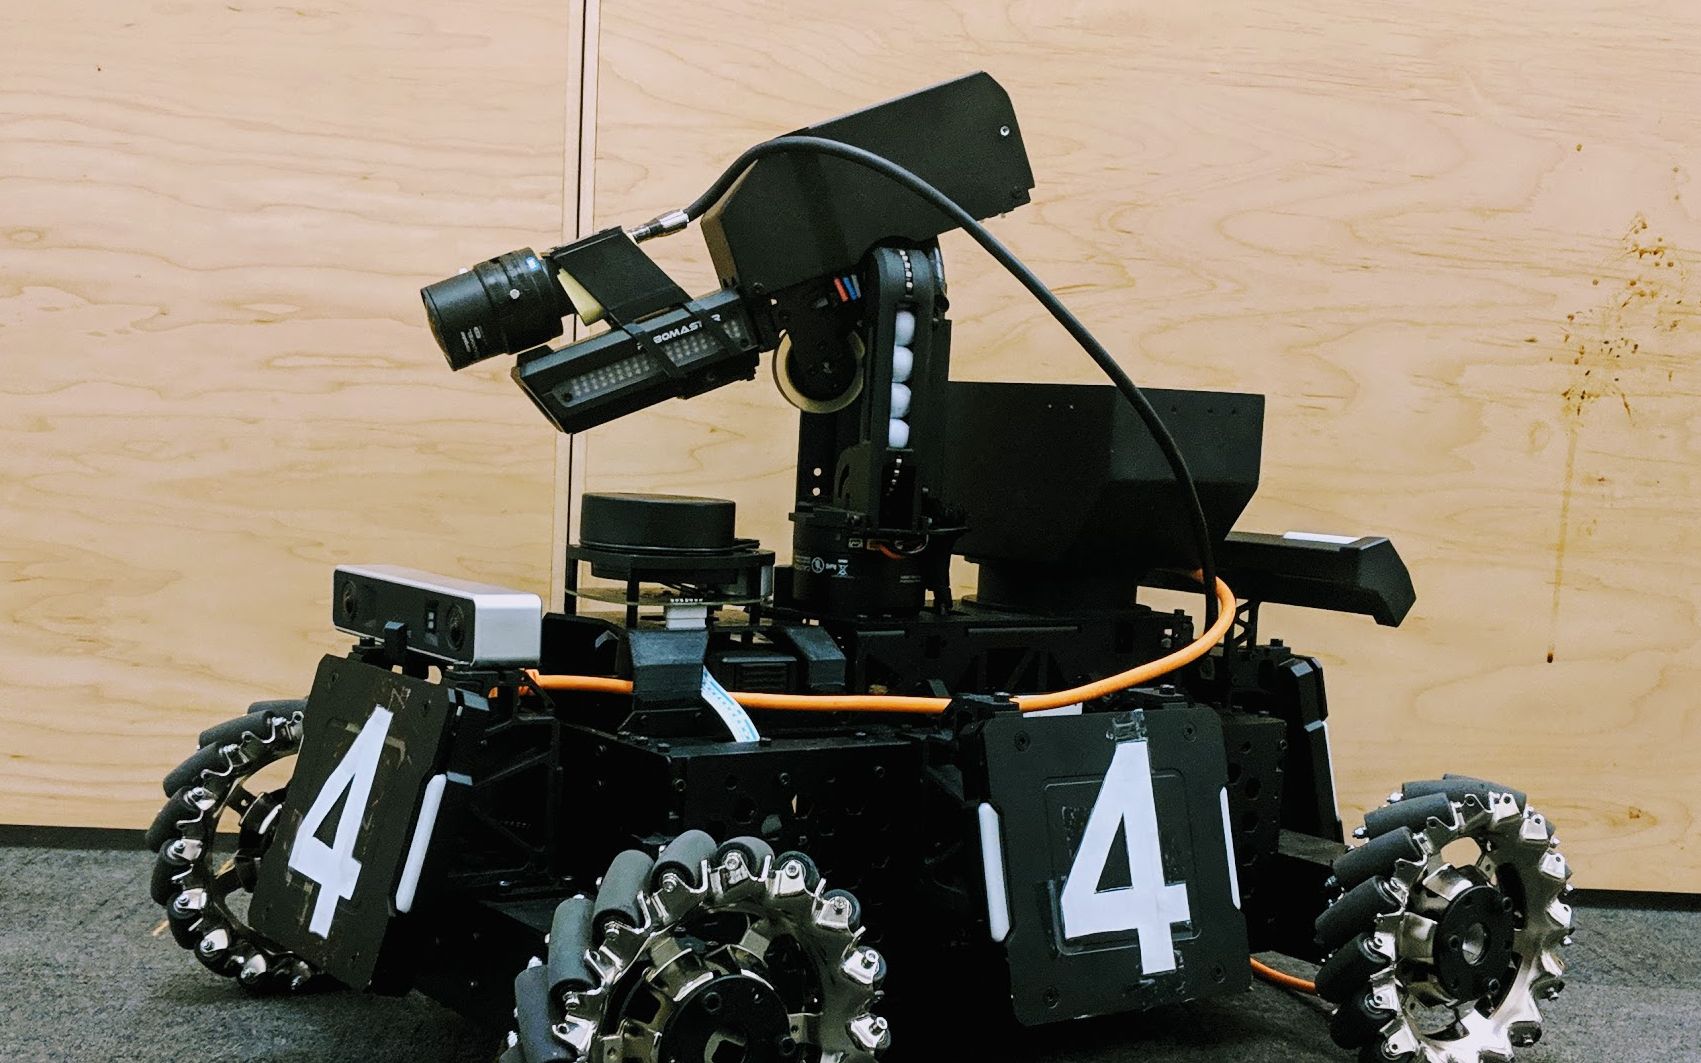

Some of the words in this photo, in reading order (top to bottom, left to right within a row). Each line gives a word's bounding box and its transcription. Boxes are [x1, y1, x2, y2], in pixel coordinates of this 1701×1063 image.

[636, 313, 721, 350] BOMASTR
[287, 704, 394, 939] 4
[1061, 740, 1191, 975] 4
